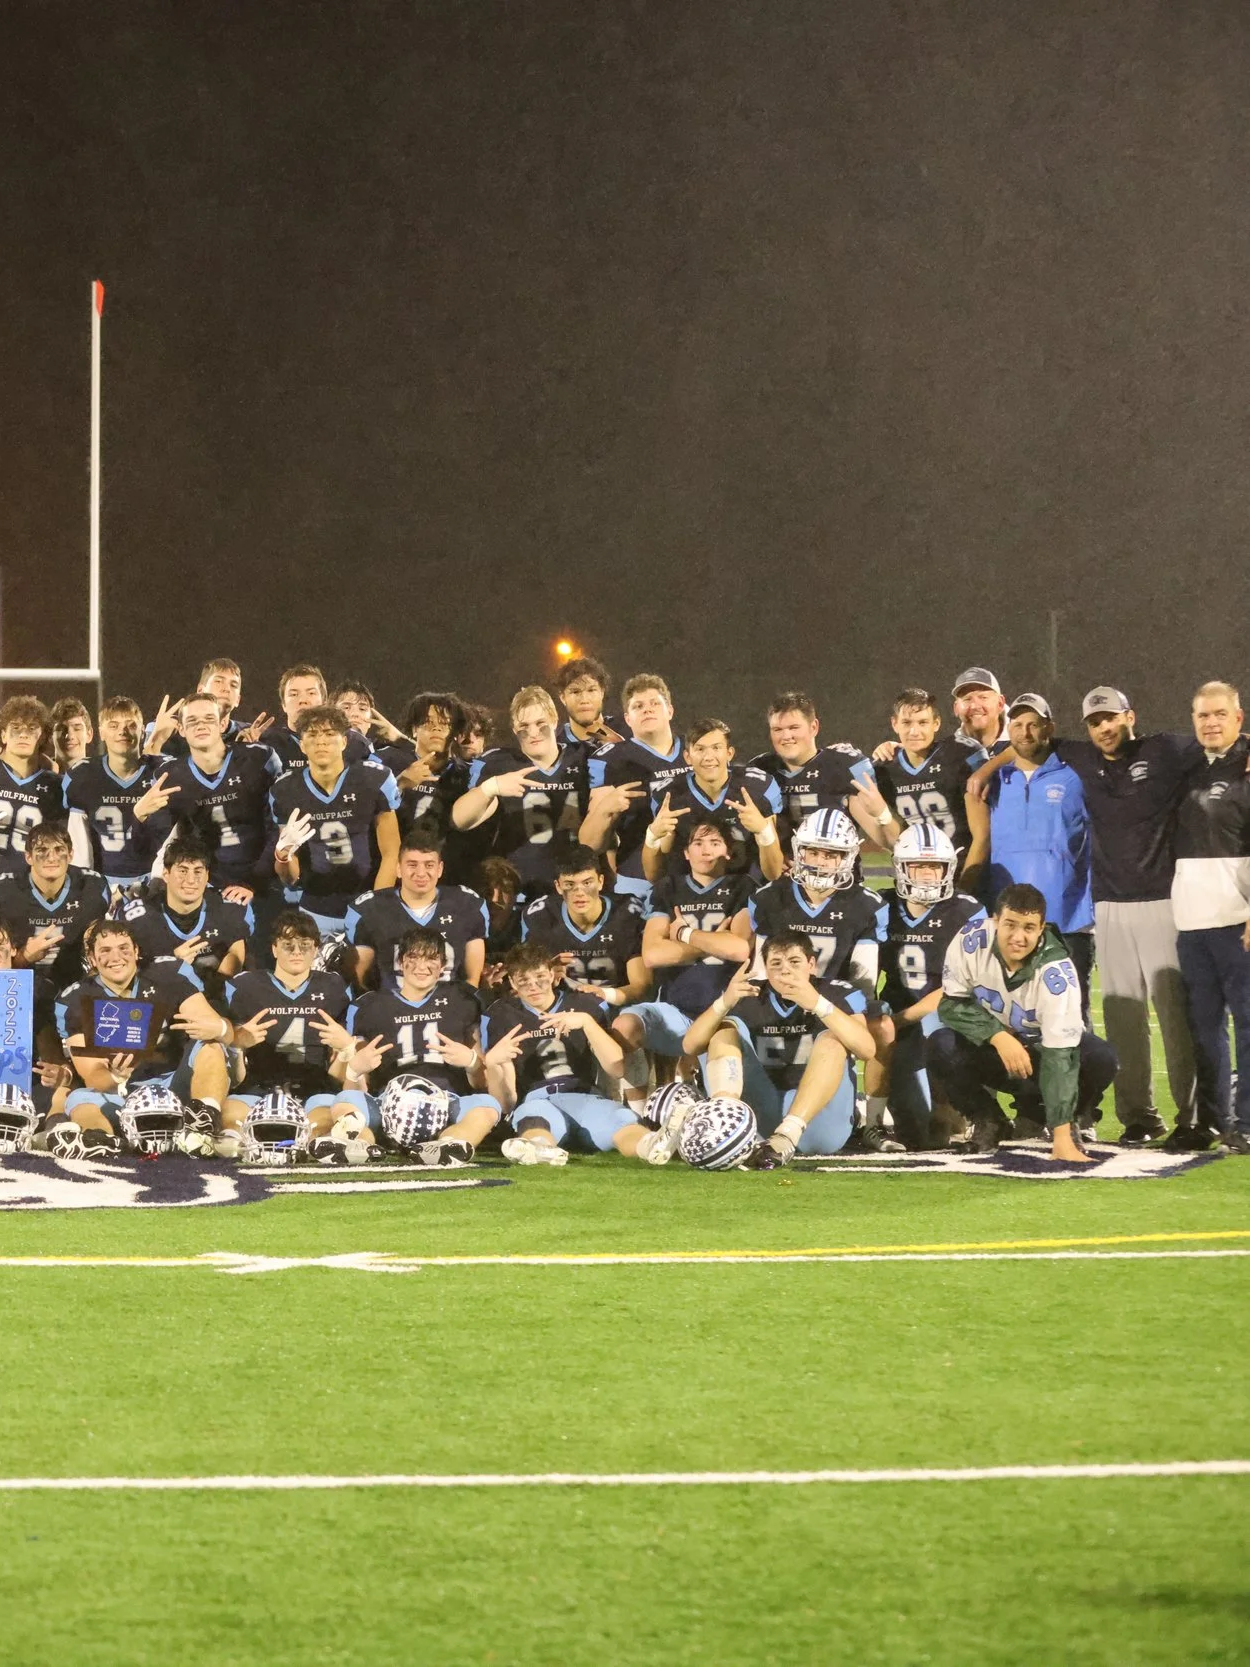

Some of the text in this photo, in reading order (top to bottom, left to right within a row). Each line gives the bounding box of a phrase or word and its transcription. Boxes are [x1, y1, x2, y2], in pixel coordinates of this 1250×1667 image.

[896, 781, 936, 794] WOLFPACK
[102, 796, 144, 804] WOLFPAC
[195, 792, 238, 806] WOLFPACK
[309, 809, 353, 821] WOLFPACK
[680, 902, 724, 912] WOLFPACK
[28, 917, 74, 926] WOLFPACK
[788, 924, 834, 934] WOLFPACK
[269, 1006, 317, 1015] WOLFPACK
[394, 1011, 442, 1024] WOLFPACK
[763, 1024, 807, 1034] WOLFPACK
[396, 1022, 445, 1066] 11
